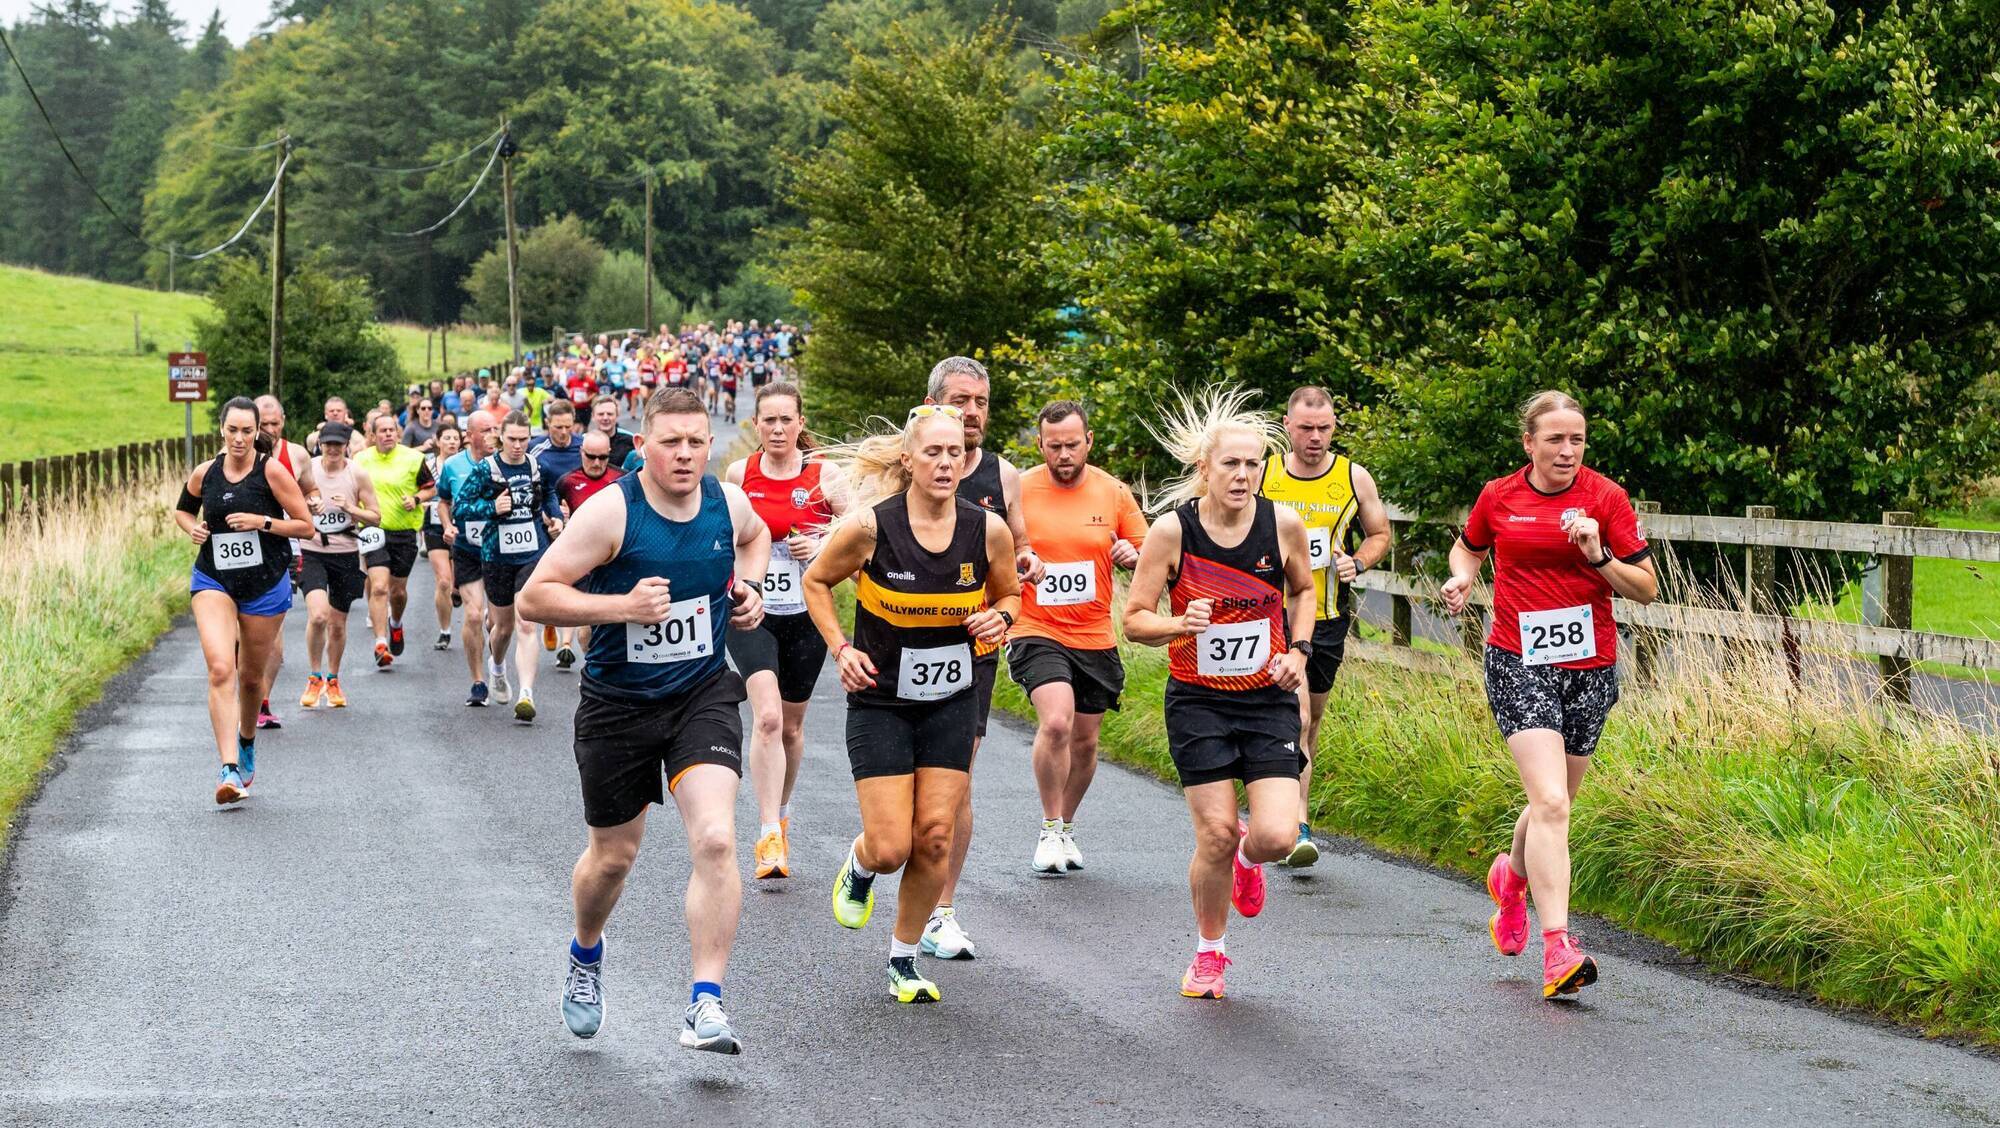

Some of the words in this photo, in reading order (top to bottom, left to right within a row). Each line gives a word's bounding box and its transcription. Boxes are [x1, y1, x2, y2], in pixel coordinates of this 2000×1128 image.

[319, 512, 346, 526] 286
[504, 530, 533, 545] 300
[219, 540, 254, 559] 368
[886, 570, 916, 581] oneills
[1045, 573, 1087, 593] 309
[941, 606, 969, 616] COBH
[1221, 596, 1259, 611] Sligo
[1262, 592, 1278, 606] AC
[643, 615, 696, 647] 301
[1530, 621, 1585, 650] 258
[1209, 634, 1260, 661] 377
[911, 659, 961, 686] 378
